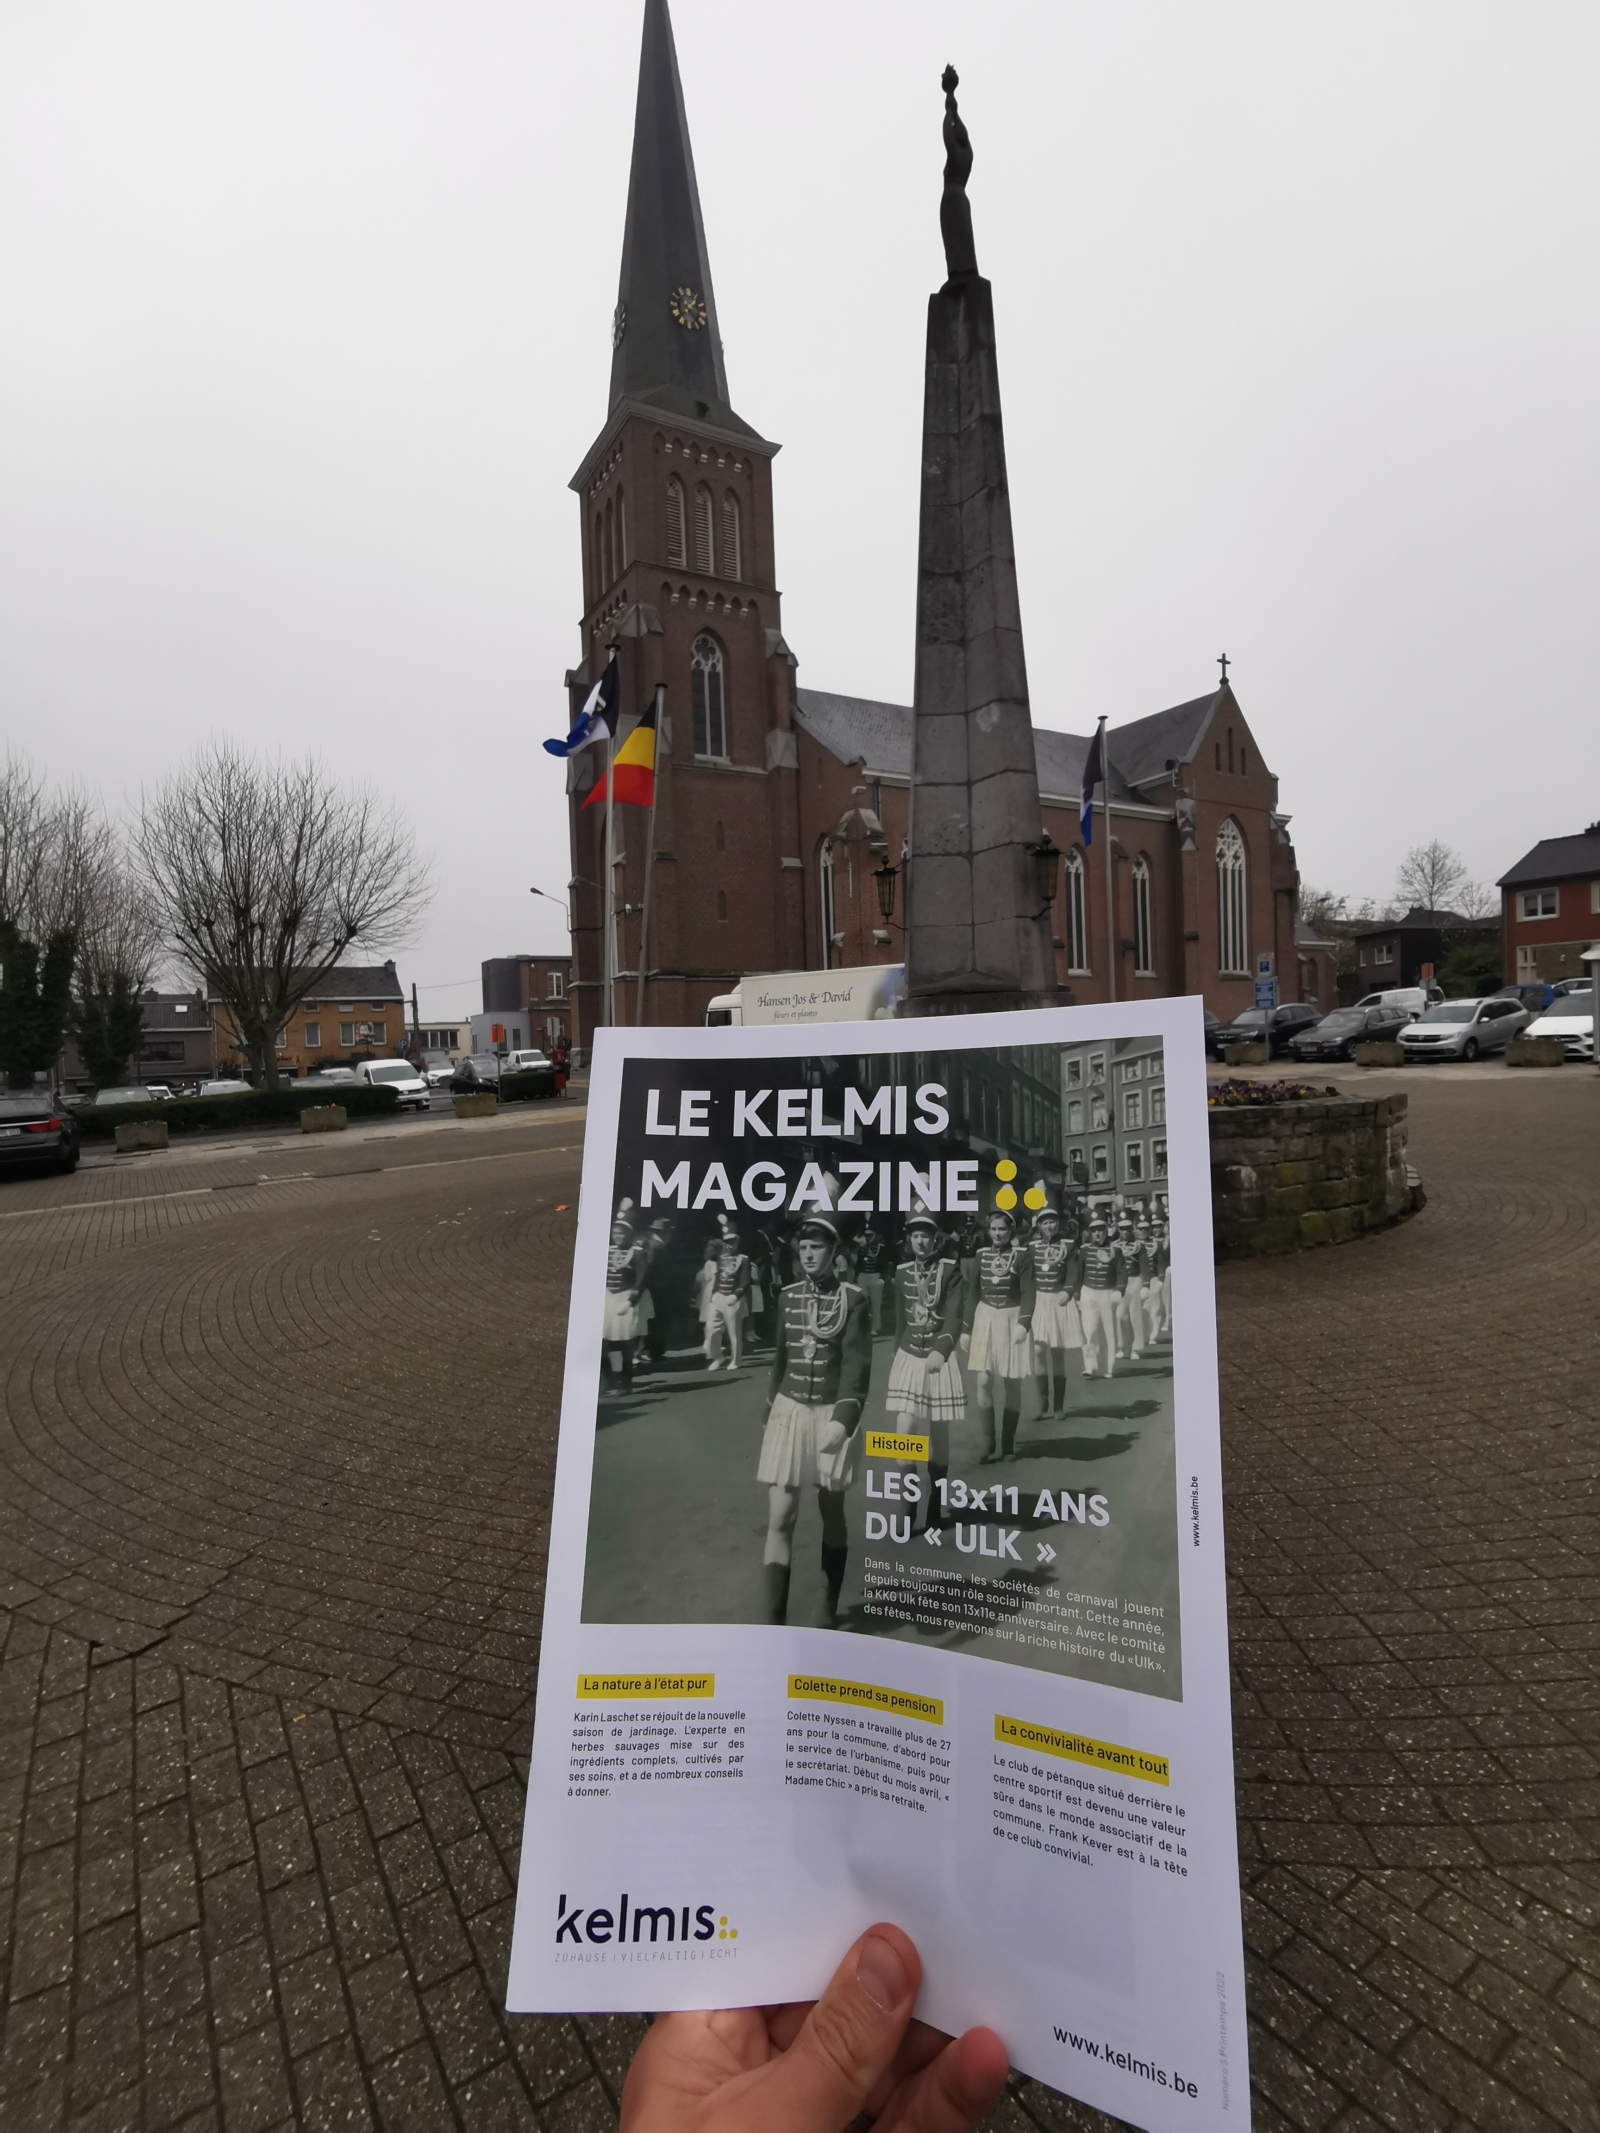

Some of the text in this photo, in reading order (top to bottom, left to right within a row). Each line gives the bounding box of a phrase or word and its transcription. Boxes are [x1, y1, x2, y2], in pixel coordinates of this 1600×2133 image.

[757, 987, 853, 1007] Hansen Jos & David
[773, 1010, 789, 1020] fleurs
[797, 1010, 818, 1019] plantes
[401, 1040, 407, 1050] P
[644, 1083, 949, 1137] LE KELMIS
[640, 1159, 979, 1212] MAGAZINE
[871, 1437, 923, 1453] Histoire
[866, 1470, 1110, 1526] LES 13x11 ANS
[1191, 1476, 1201, 1547] www.kelmis.be
[866, 1512, 911, 1543] DU
[955, 1523, 1022, 1561] ULK
[864, 1573, 1165, 1636] depuis toujours un rôle social important. Cette année,
[865, 1558, 1164, 1619] Dans commune, les sociétés de carnaval jouent
[864, 1603, 1166, 1673] des fêtes, nous revenons sur la riche histoire du «Ulk».
[875, 1590, 1166, 1654] KKG Ulk fête son 13x11e anniversaire. Avec le comité
[584, 1678, 599, 1690] La
[602, 1678, 641, 1690] nature
[687, 1678, 707, 1691] pur
[794, 1679, 936, 1714] Colette prend sa pension
[573, 1727, 603, 1737] saison
[611, 1727, 623, 1736] de
[629, 1726, 676, 1738] jardinage.
[574, 1711, 746, 1723] Karin Laschet réjouit nouvelle
[787, 1711, 951, 1751] Colette Nyssen travaillé plus 27
[570, 1754, 744, 1769] ingrédients complets, cultivés par
[572, 1740, 744, 1752] herbes sauvages mise sur des
[787, 1728, 802, 1736] ans
[807, 1728, 827, 1739] pour
[844, 1733, 889, 1751] commune,
[930, 1753, 951, 1768] pour
[798, 1744, 832, 1755] service
[836, 1746, 846, 1756] de
[907, 1764, 926, 1778] puis
[930, 1771, 950, 1785] pour
[1001, 1720, 1168, 1775] La convivialité avant tout
[569, 1768, 743, 1782] ses soins, de nombreux conseils
[575, 1787, 611, 1796] donner.
[785, 1775, 927, 1812] Madame Chic pris sa retraite.
[797, 1759, 941, 1800] secrétariat. Début du mois avril,
[994, 1755, 1186, 1818] Le club de pétanque situé derrière le
[994, 1774, 1186, 1837] centre sportif est devenu une valeur
[994, 1791, 1187, 1857] sûre dans monde associatif de la
[993, 1809, 1188, 1876] commune. Frank Kever est tête
[993, 1826, 1093, 1866] de ce club convivial.
[555, 1953, 607, 1962] ZUHAUSE
[710, 1948, 738, 1958] ECHT
[1218, 2001, 1229, 2056] Printemps
[1053, 2025, 1198, 2098] www.kelmis.be
